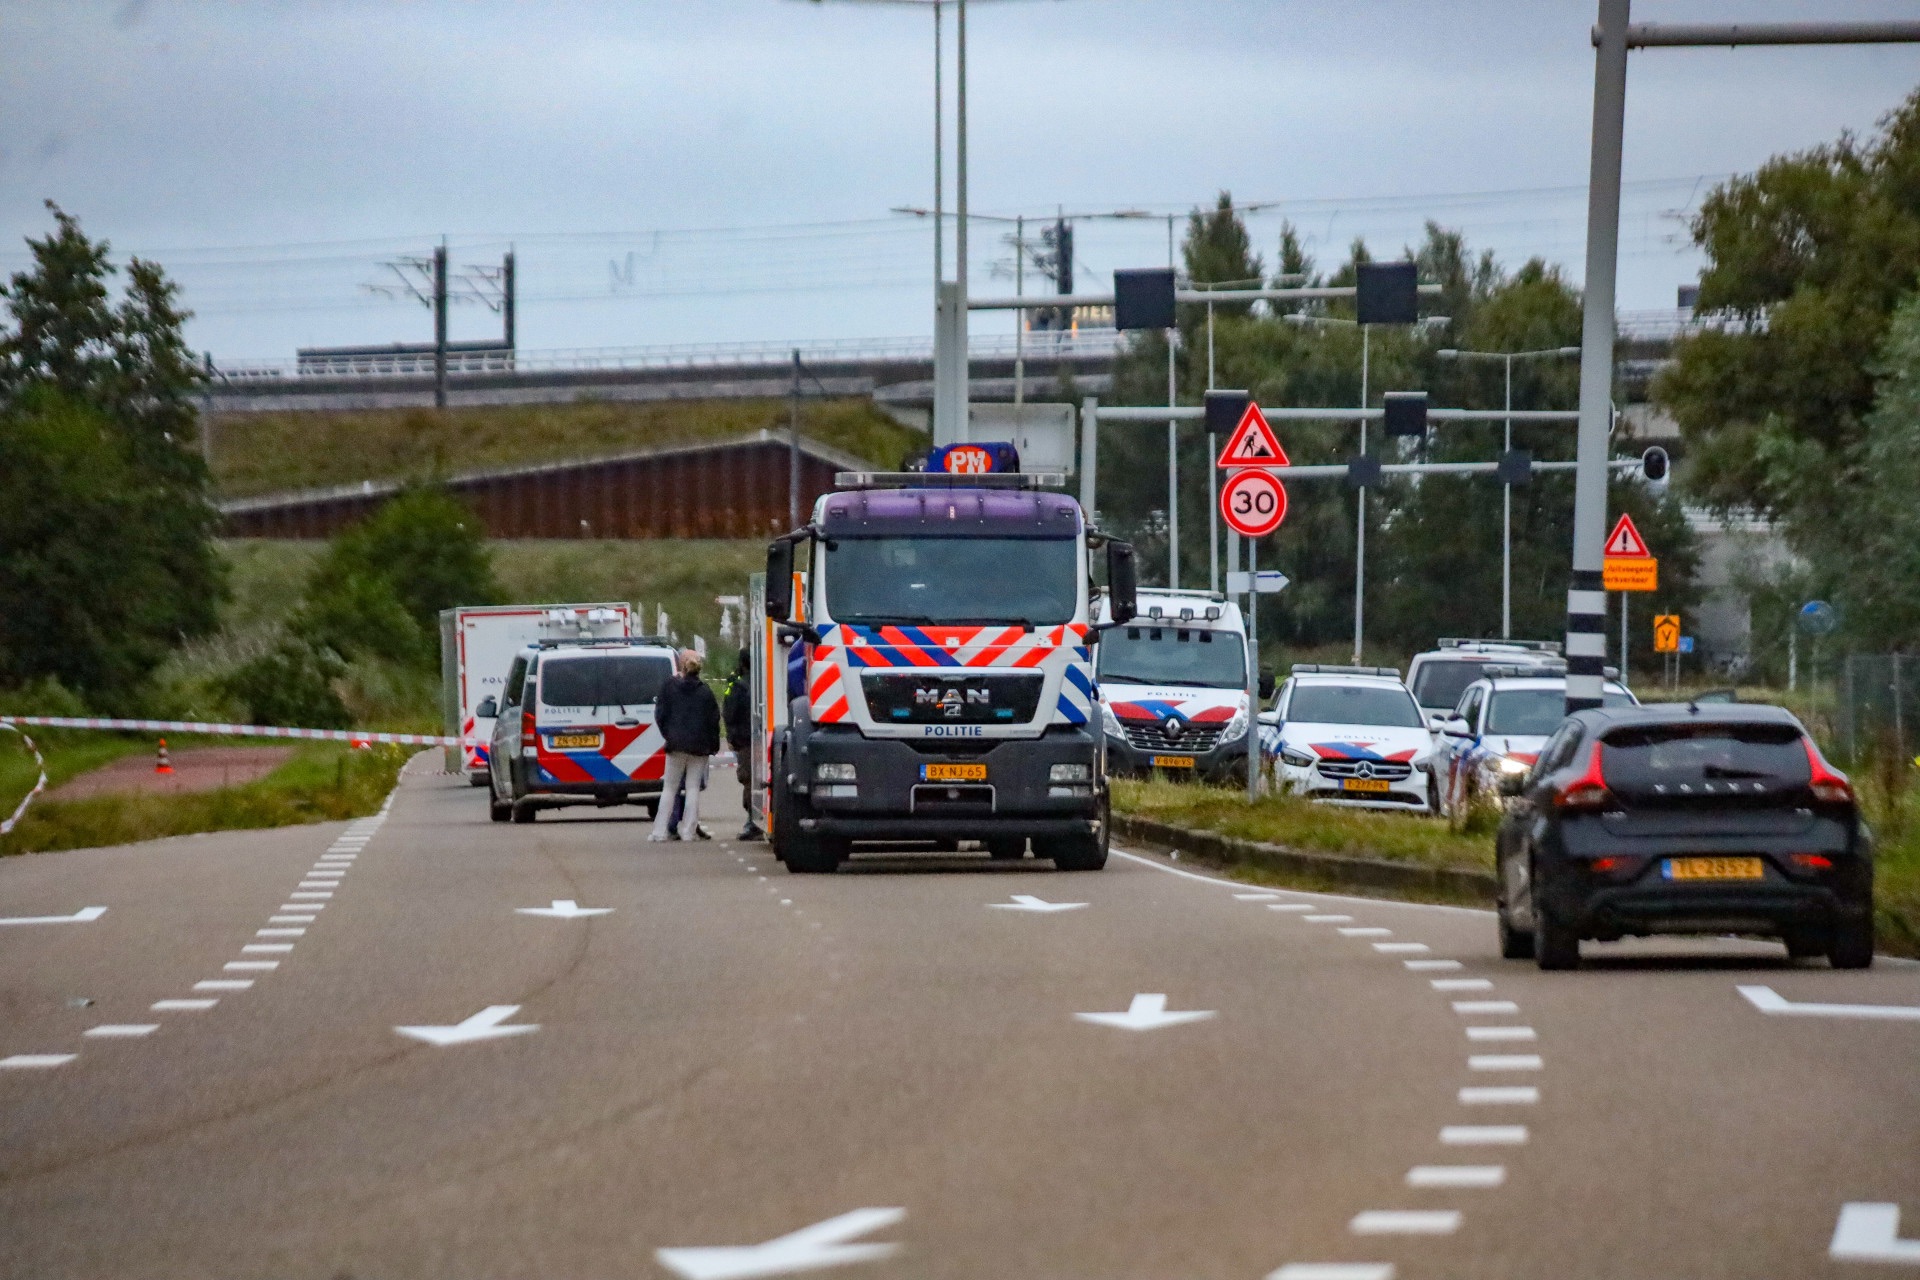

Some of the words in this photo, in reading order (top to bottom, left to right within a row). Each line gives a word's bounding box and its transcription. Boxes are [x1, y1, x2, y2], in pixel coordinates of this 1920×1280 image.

[950, 451, 985, 474] PM
[1235, 490, 1274, 514] 30
[916, 688, 989, 703] MAN
[925, 726, 982, 736] POLITIE
[930, 766, 982, 776] BX-NJ-65
[1654, 783, 1767, 793] VOLVO
